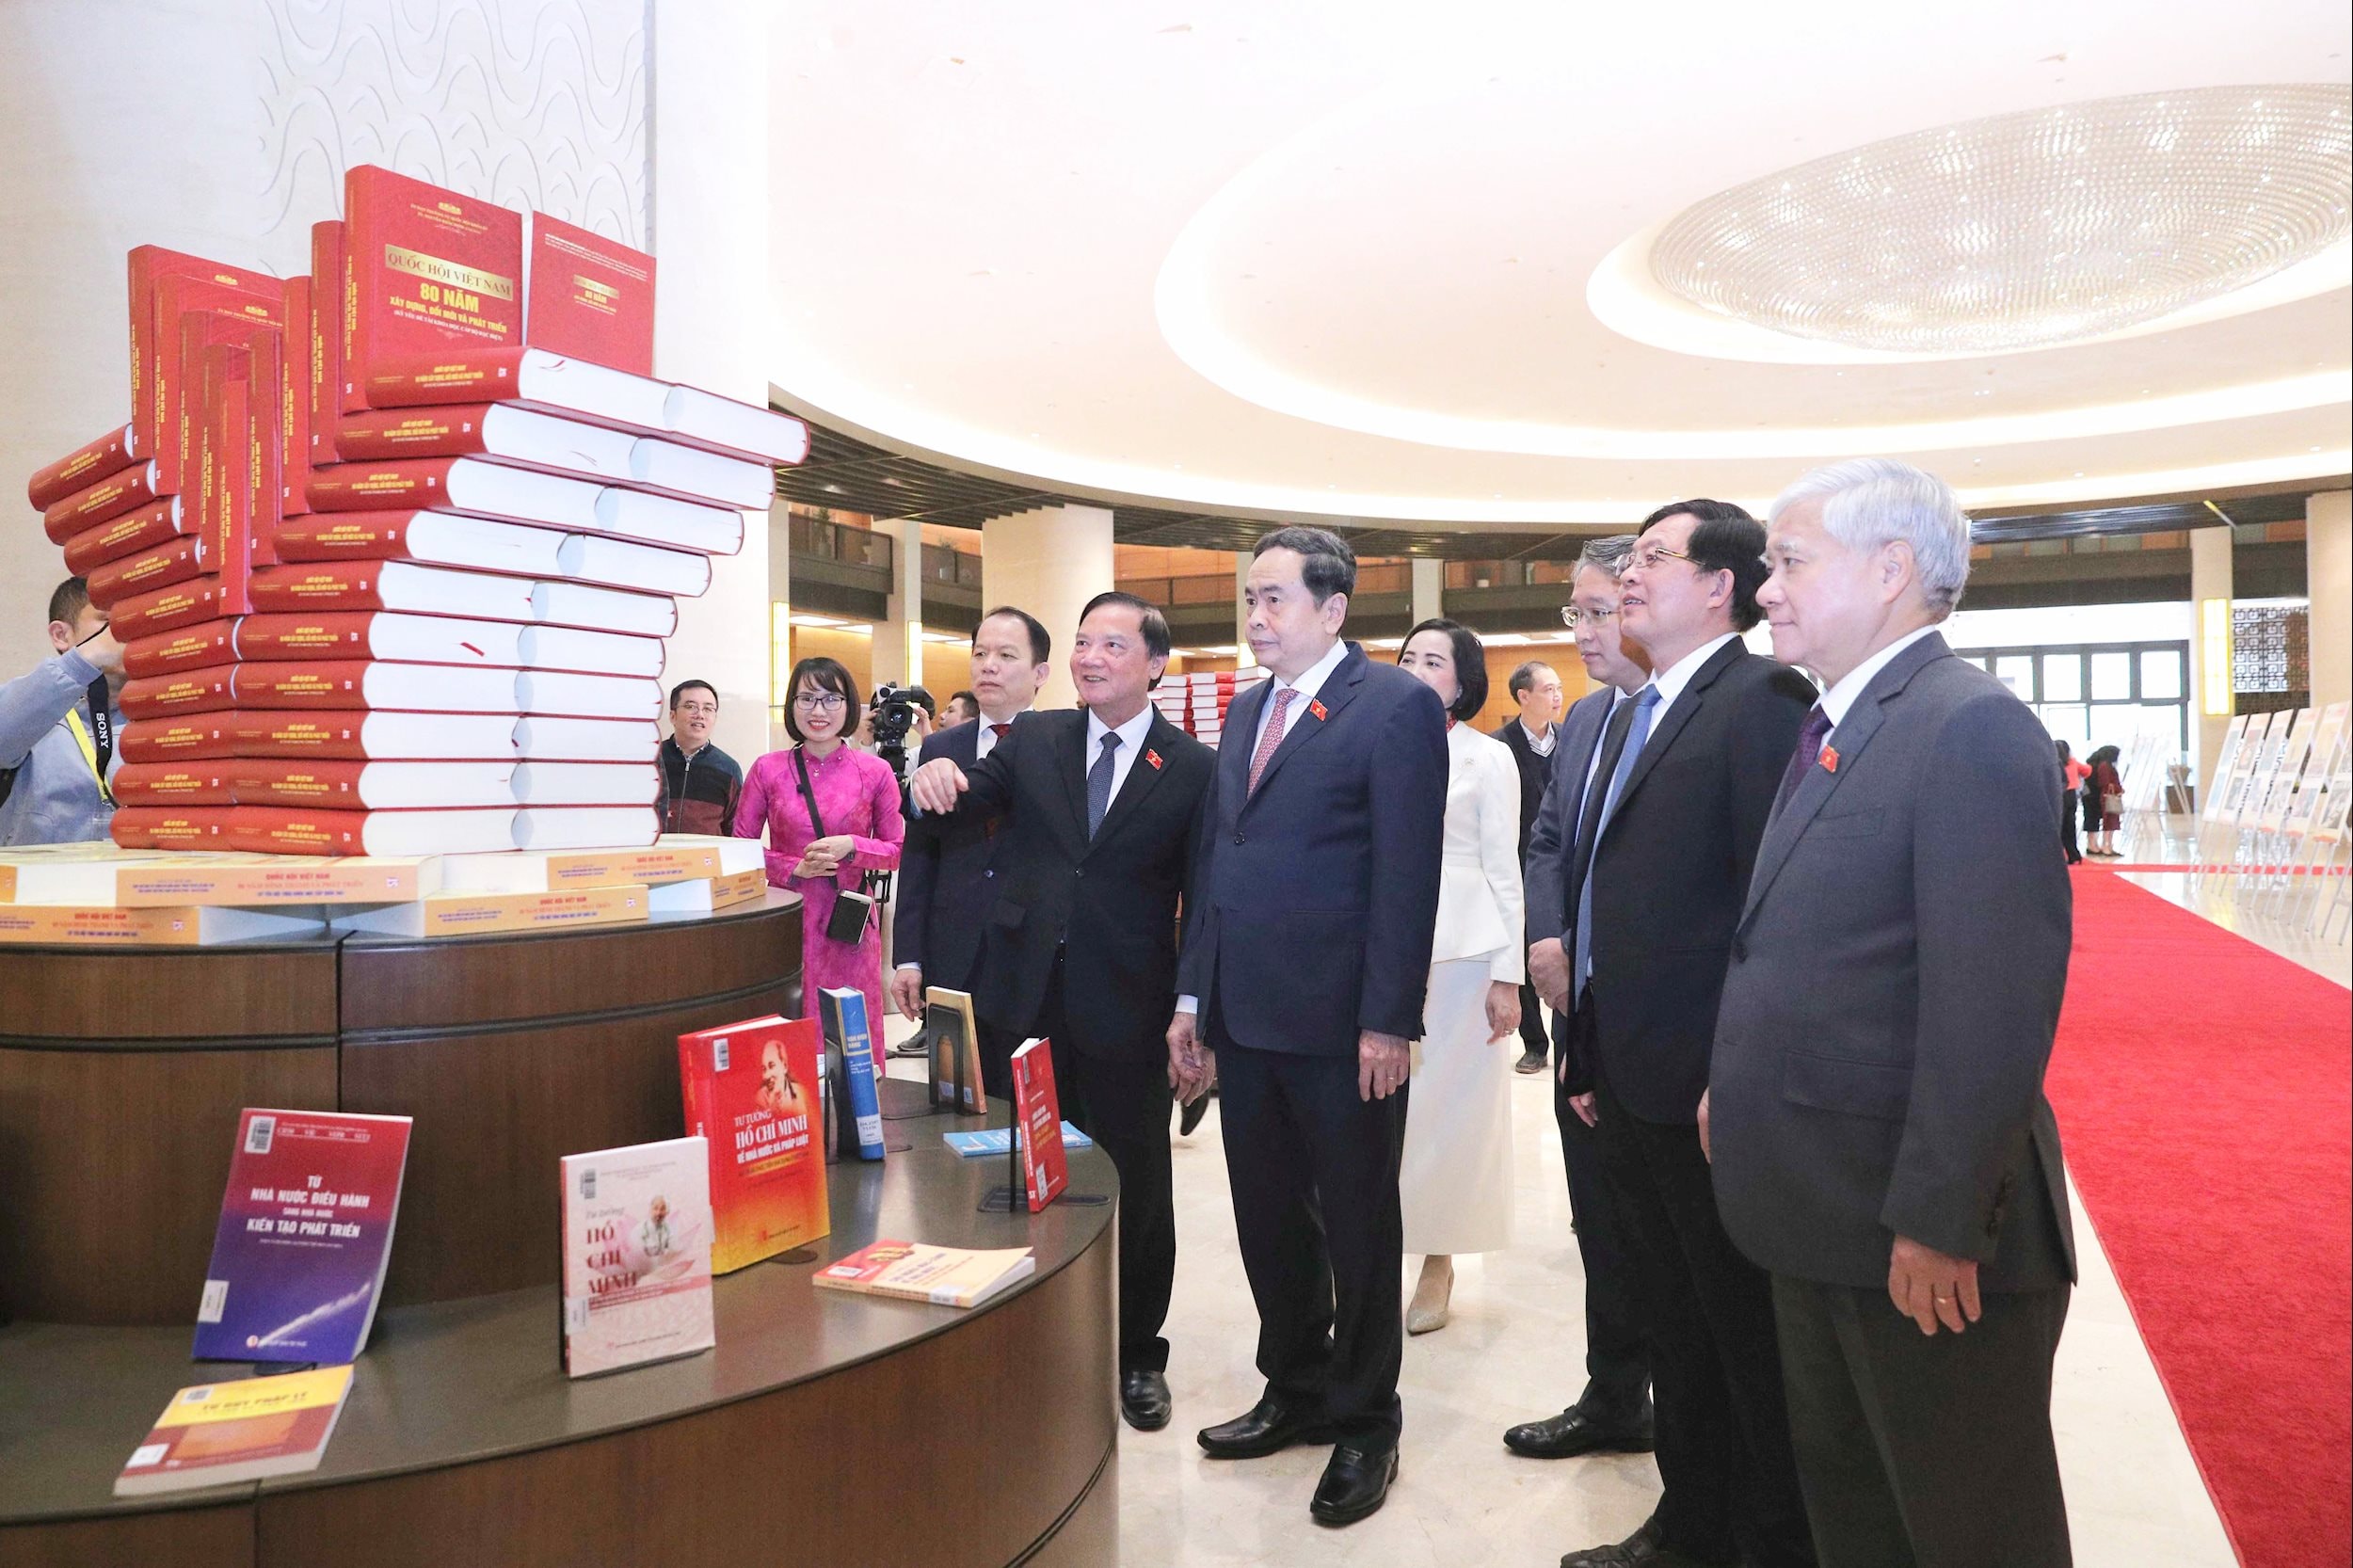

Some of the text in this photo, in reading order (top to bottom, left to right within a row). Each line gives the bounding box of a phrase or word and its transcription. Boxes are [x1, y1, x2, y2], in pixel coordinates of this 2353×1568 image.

[388, 253, 511, 296] QUỐC HỘI VIỆT NAM
[390, 296, 405, 308] XÂY
[420, 283, 479, 313] 80 NĂM
[96, 712, 108, 748] SONY
[734, 1109, 772, 1127] TƯ TƯỞNG
[735, 1113, 808, 1149] HỒ CHÍ MINH
[250, 1187, 274, 1201] NHÀ
[277, 1189, 308, 1204] NƯỚC
[340, 1192, 370, 1208] HÀNH
[247, 1217, 274, 1233] KIẾN
[277, 1219, 297, 1234] TẠO
[299, 1221, 328, 1235] PHÁT
[587, 1220, 615, 1244] HỒ
[586, 1245, 620, 1269] CHÍ
[588, 1272, 637, 1294] MINH
